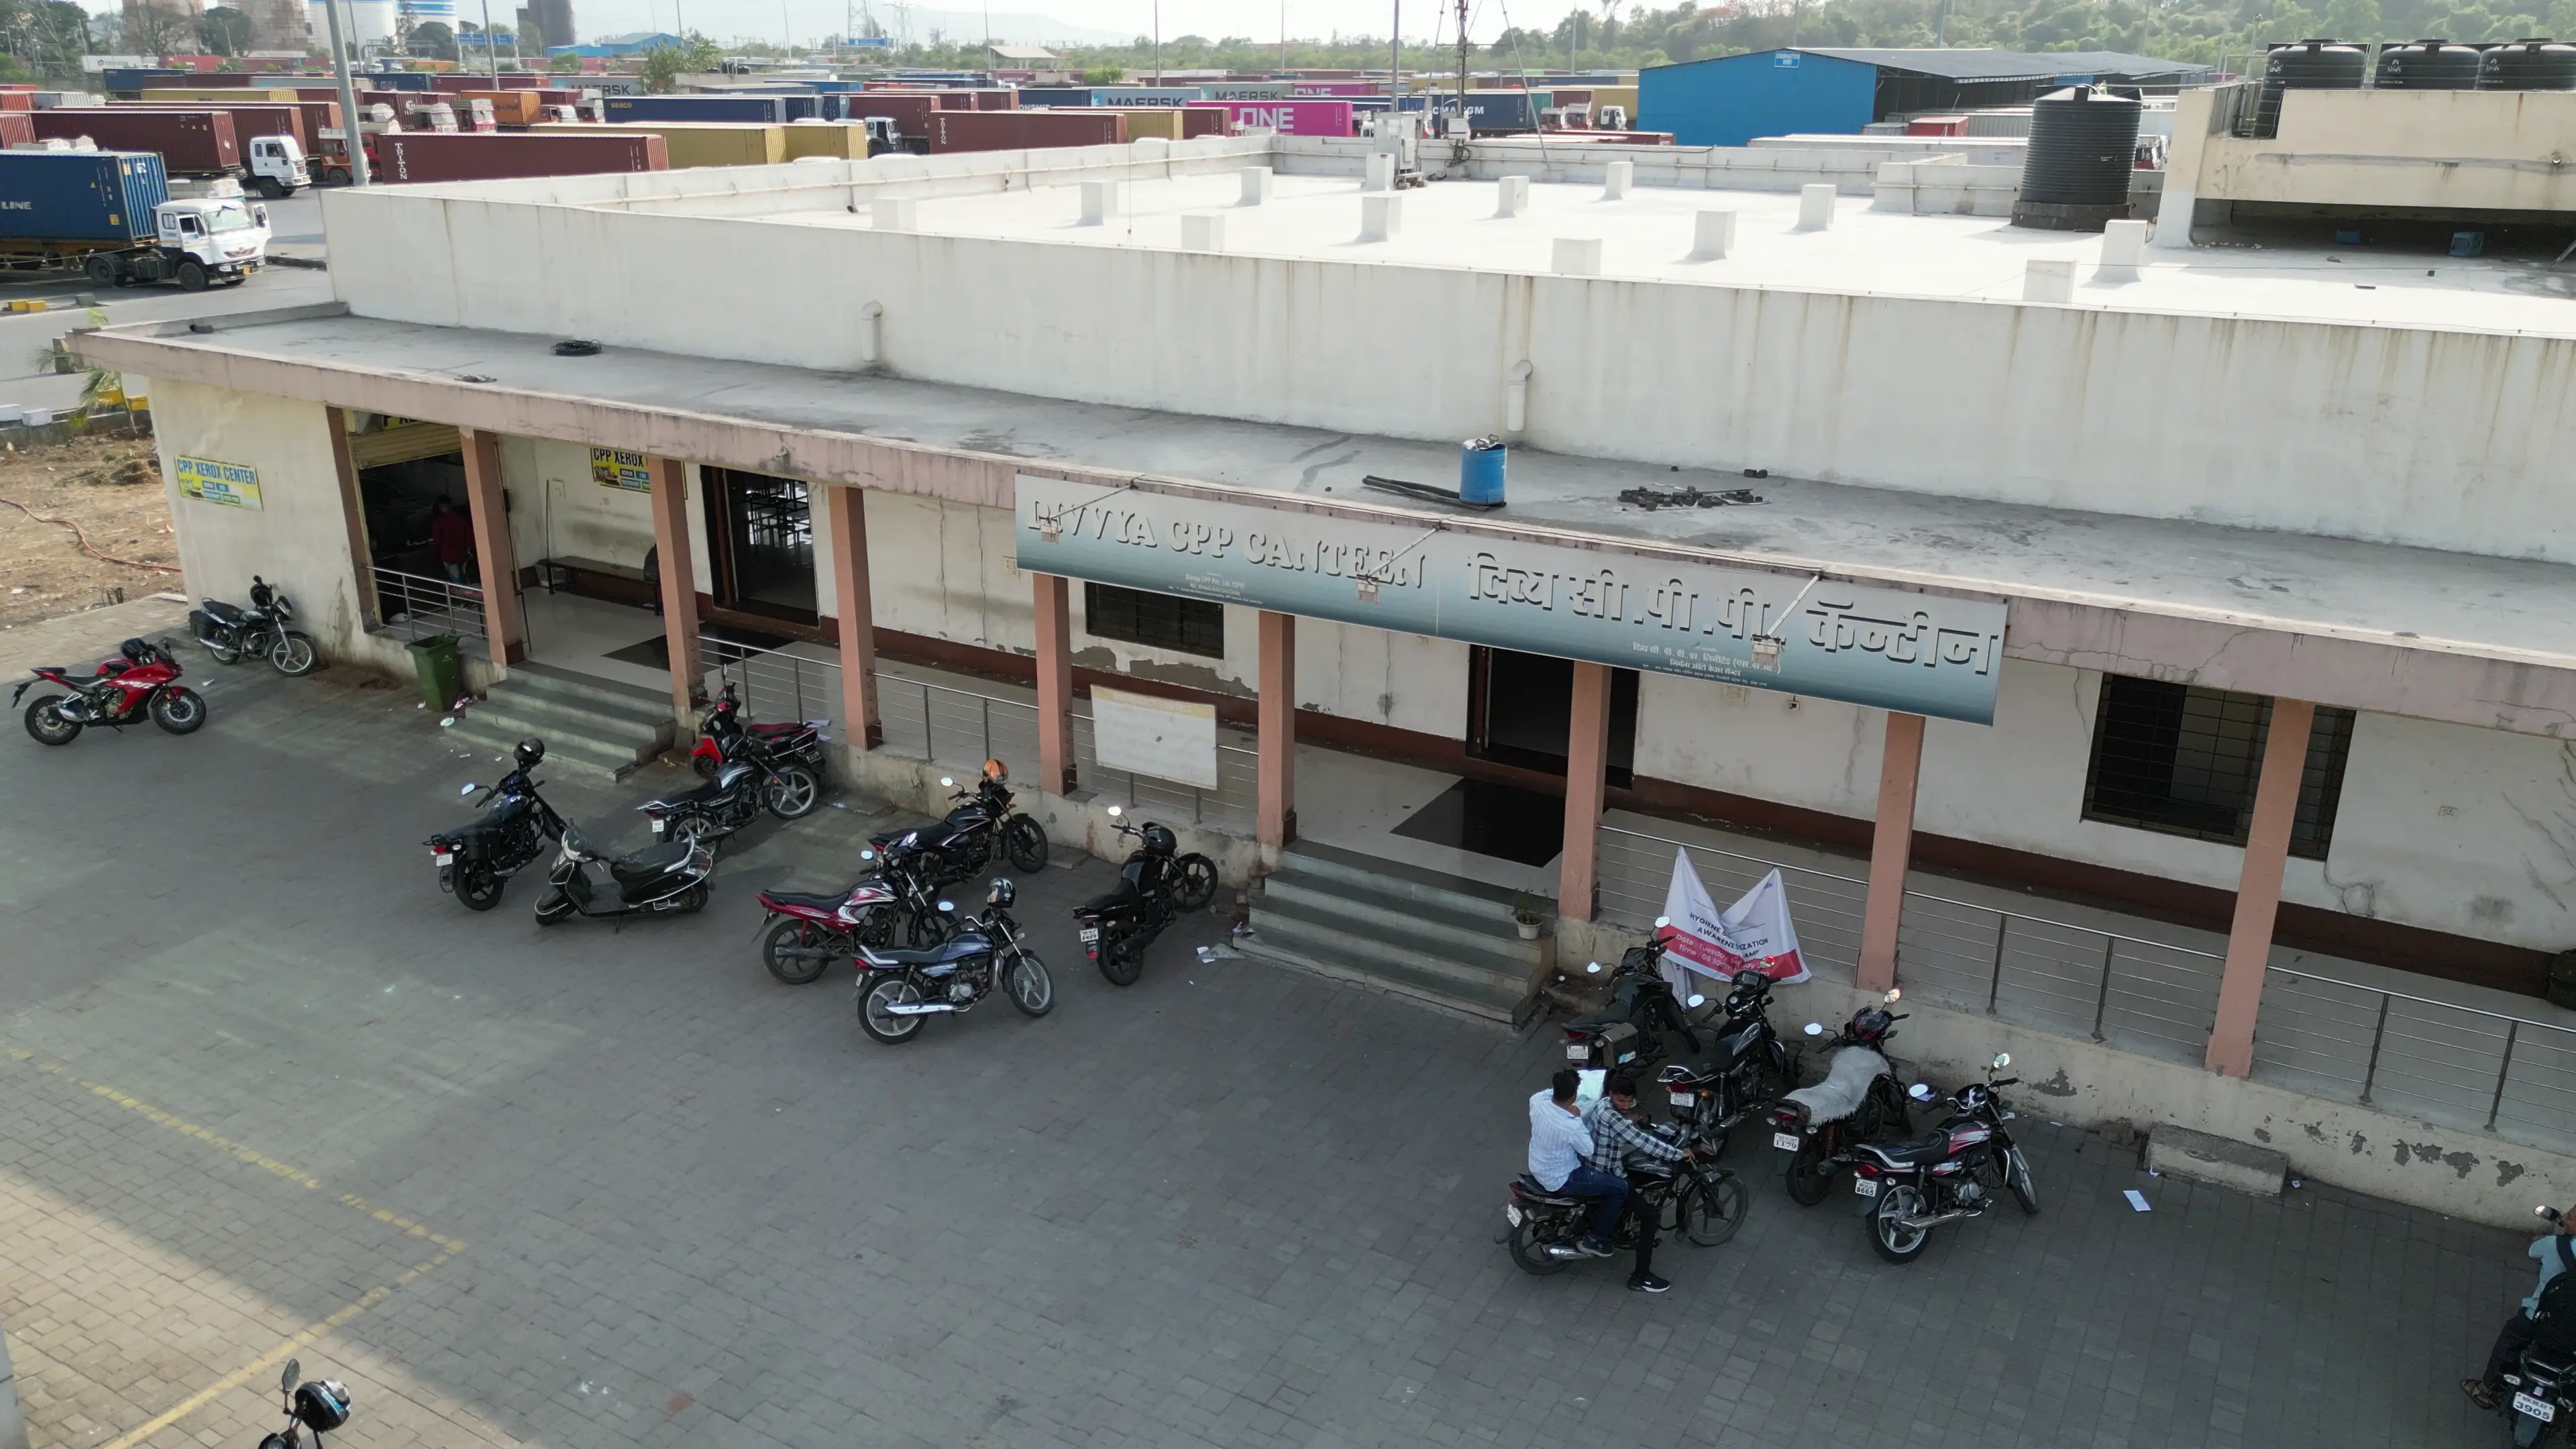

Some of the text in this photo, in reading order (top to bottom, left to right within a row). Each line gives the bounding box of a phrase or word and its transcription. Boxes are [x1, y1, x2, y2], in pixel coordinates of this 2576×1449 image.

[1108, 97, 1183, 106] MAERSK
[1215, 91, 1278, 101] MAERSK
[1240, 107, 1294, 129] ONE
[1464, 106, 1485, 115] GM
[394, 142, 408, 180] TRITON
[2, 201, 32, 210] LINE
[593, 447, 644, 468] CPP XEROX
[176, 459, 256, 485] CPP XEROX CENTER
[1169, 520, 1234, 559] CPP
[1246, 533, 1426, 590] CANTEEN
[1466, 551, 1560, 611] दिव्य
[1689, 912, 1722, 934] HYGIENE
[1676, 933, 1694, 945] Date
[1678, 943, 1697, 956] Time
[1776, 1140, 1797, 1149] 1179
[1856, 1186, 1874, 1196] 8665
[2515, 1401, 2551, 1420] 3905
